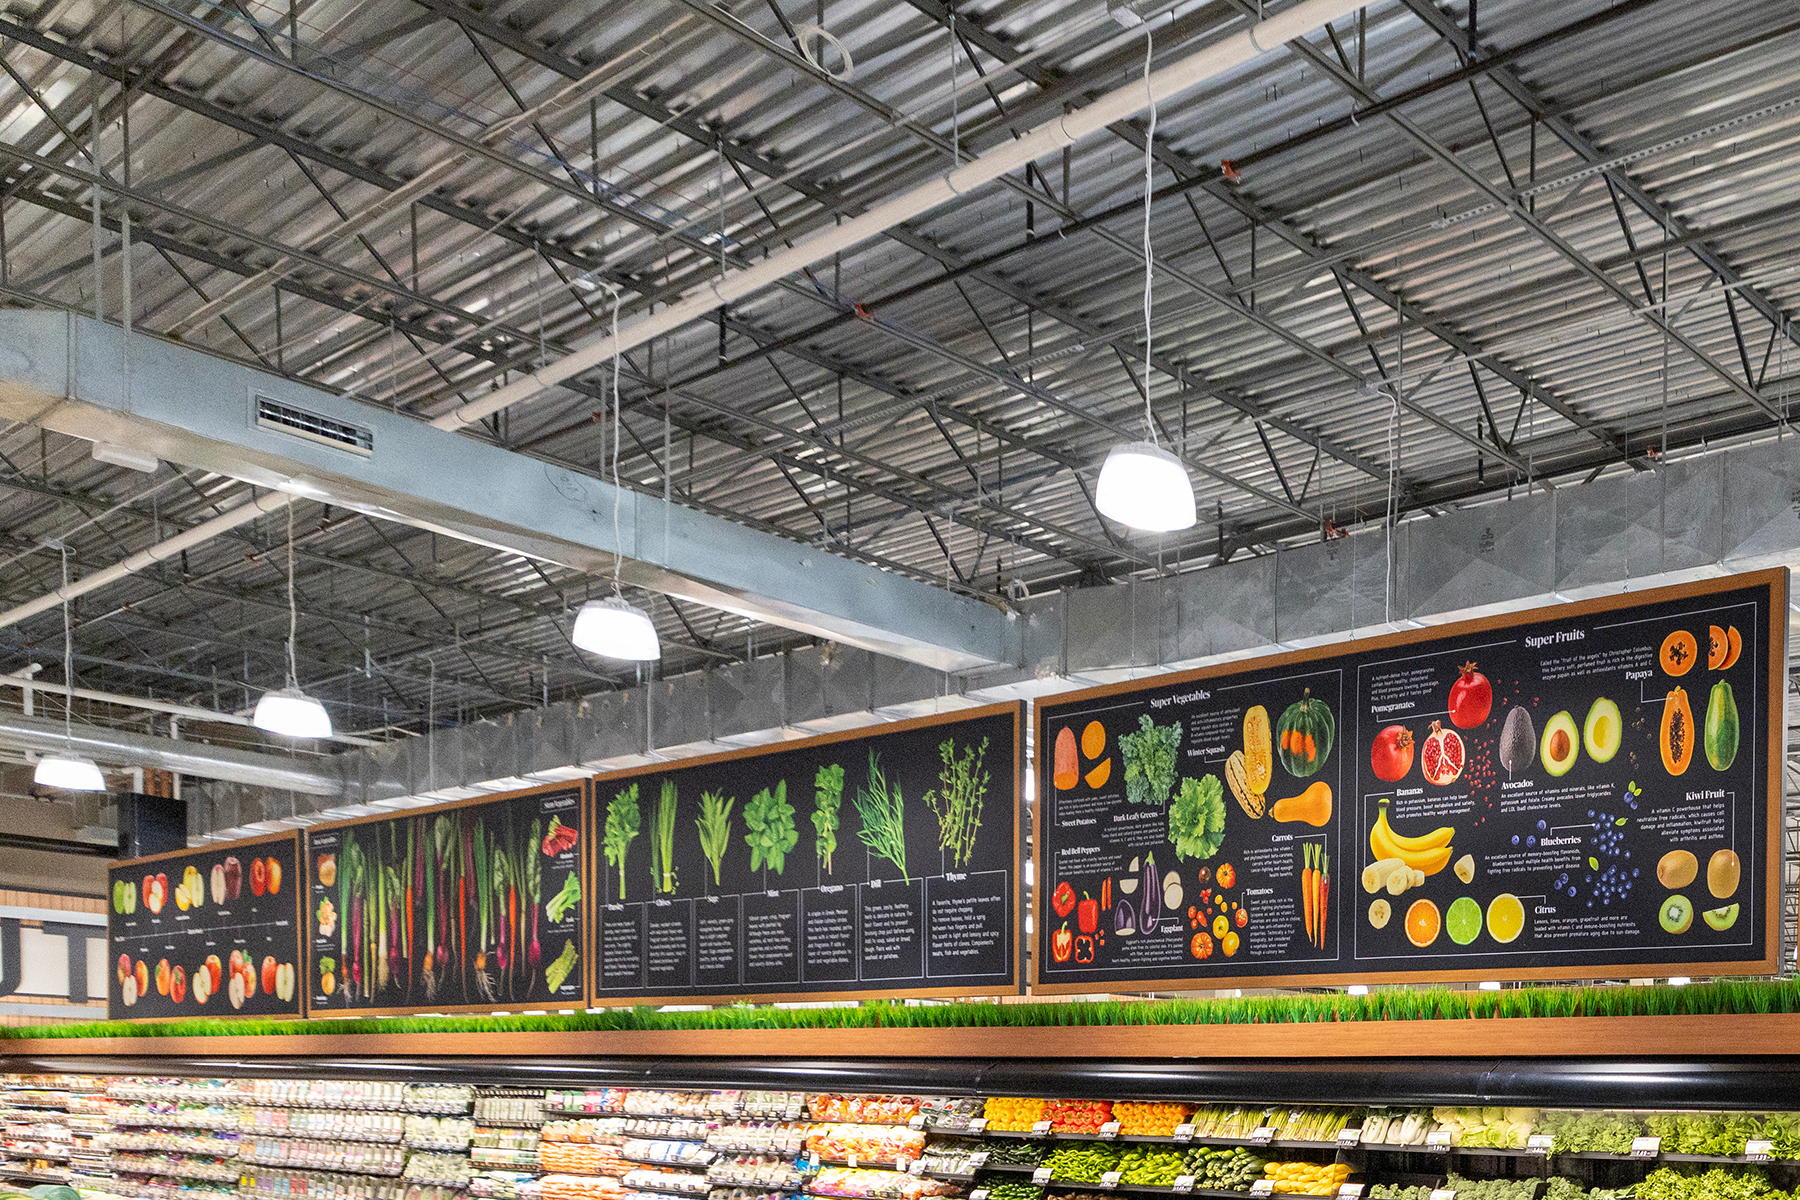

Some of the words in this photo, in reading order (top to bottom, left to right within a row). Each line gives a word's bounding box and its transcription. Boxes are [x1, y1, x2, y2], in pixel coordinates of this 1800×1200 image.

[1524, 634, 1555, 649] Super
[1555, 628, 1586, 644] Fruits
[1625, 669, 1653, 681] Papaya
[1150, 697, 1172, 710] Super
[1172, 689, 1211, 706] Vegetables
[1370, 701, 1416, 714] Pomegranates
[1186, 748, 1206, 757] Winter
[1205, 744, 1226, 756] Squash
[1501, 778, 1534, 790] Avocados
[1396, 787, 1424, 797] Bananas
[1685, 790, 1705, 801] Kiwi
[1704, 788, 1725, 800] Fruit
[1540, 835, 1582, 847] Blueberries
[1245, 887, 1274, 896] Tomatoes
[1534, 905, 1557, 915] Citrus
[1160, 924, 1184, 934] Eggplant
